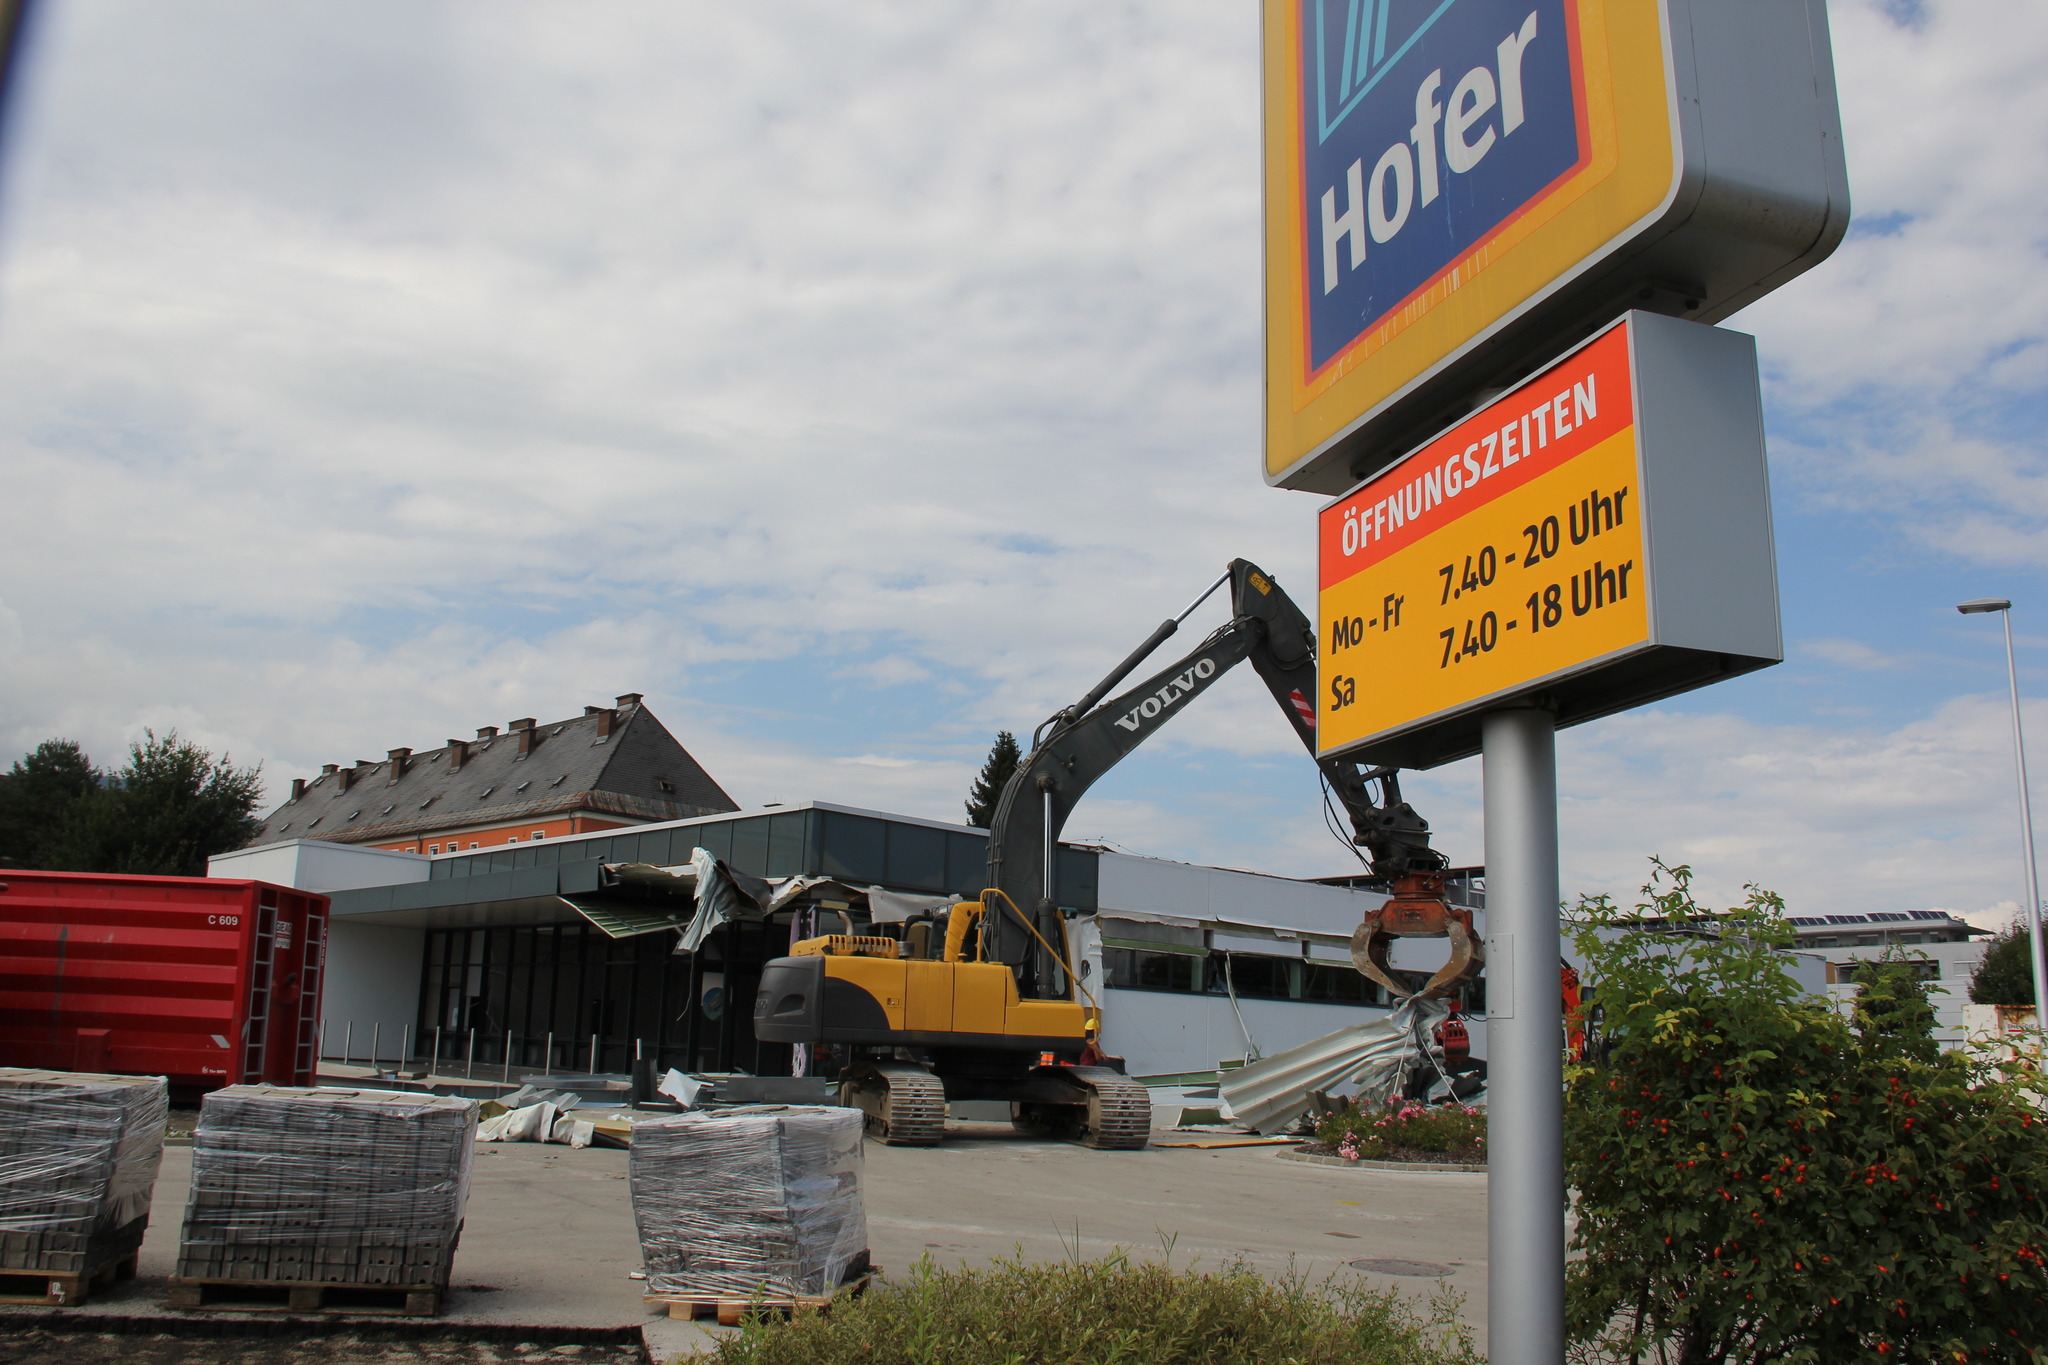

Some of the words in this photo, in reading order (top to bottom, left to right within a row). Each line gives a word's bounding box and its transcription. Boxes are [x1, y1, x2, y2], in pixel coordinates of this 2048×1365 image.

[1322, 10, 1537, 296] Hofer
[1342, 373, 1597, 557] ÖFFNUNGSZEITEN
[1331, 615, 1364, 655] Mo
[1369, 618, 1378, 628] -
[1383, 593, 1405, 632] Fr
[1439, 545, 1497, 606] 7.40
[1505, 552, 1516, 564] -
[1522, 515, 1560, 569] 20
[1569, 486, 1628, 546] Uhr
[1331, 674, 1356, 712] Sa
[1439, 610, 1498, 669] 7.40
[1506, 619, 1517, 631] -
[1526, 583, 1563, 634] 18
[1571, 559, 1633, 617] Uhr
[1114, 658, 1216, 732] VOLVO
[208, 915, 216, 925] C
[219, 916, 238, 926] 609
